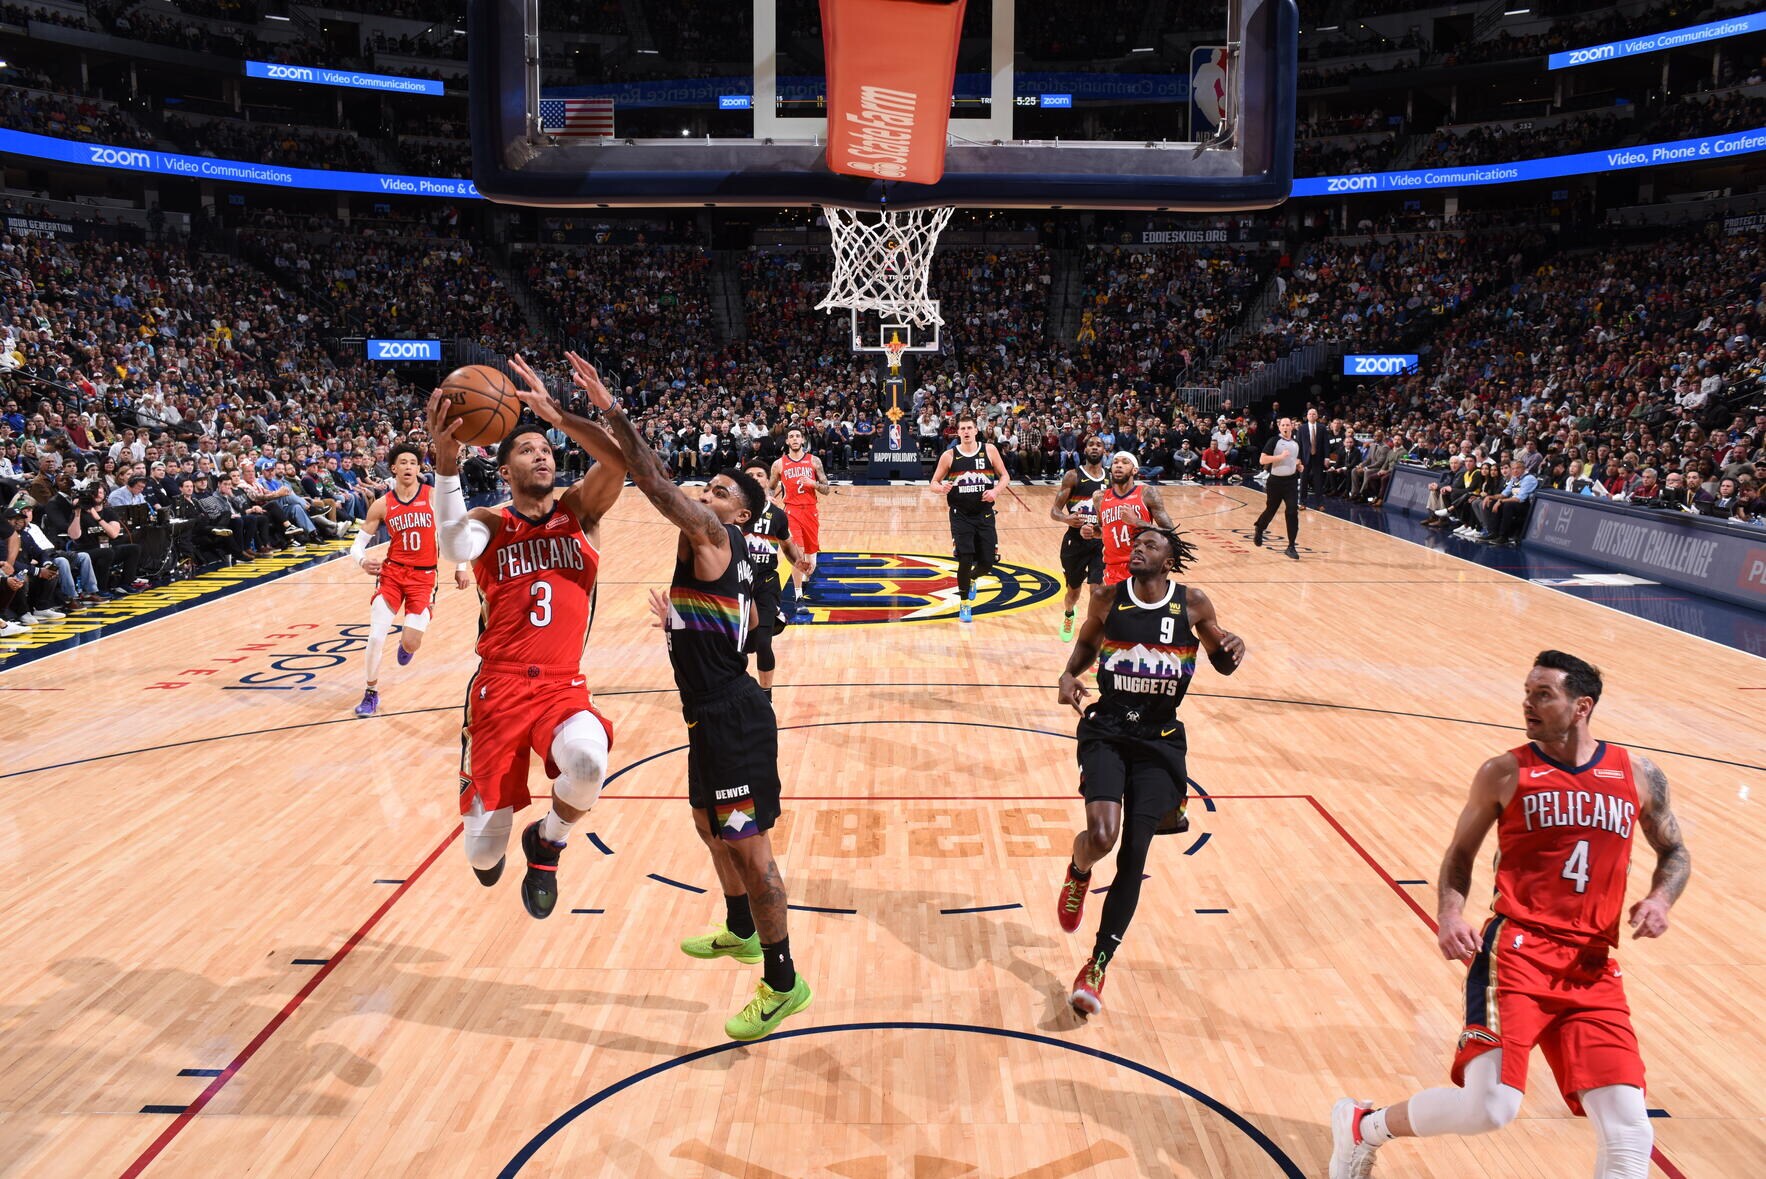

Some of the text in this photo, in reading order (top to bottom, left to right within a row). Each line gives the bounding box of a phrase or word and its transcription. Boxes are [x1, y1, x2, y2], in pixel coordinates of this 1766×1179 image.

[1569, 21, 1749, 64] zoom Video Communications
[267, 65, 426, 91] zoom Video Communications
[721, 98, 748, 106] zoom
[1016, 96, 1037, 106] 5:25
[1043, 97, 1069, 105] zoom
[1608, 153, 1649, 166] Video,
[1652, 146, 1696, 161] Phone
[1699, 142, 1711, 155] &
[90, 147, 292, 183] zoom Video Communications
[380, 178, 417, 192] Video,
[420, 181, 455, 193] Phone
[457, 184, 466, 194] &
[1328, 168, 1518, 191] zoom Video Communications
[1142, 230, 1227, 243] EDDIESKIDS.ORG
[378, 342, 430, 357] zoom
[1355, 358, 1406, 372] zoom
[874, 452, 917, 462] HAPPY HOLIDAYS
[975, 458, 985, 470] 15
[784, 466, 813, 480] PELICANS
[958, 484, 985, 493] NUGGETS
[389, 512, 432, 532] PELICANS
[1102, 504, 1141, 526] PELICS
[754, 518, 770, 534] 27
[402, 531, 421, 551] 10
[1112, 525, 1130, 548] 14
[497, 536, 584, 581] PELICANS
[752, 553, 770, 564] GETS
[1592, 519, 1719, 578] HOTSHOT CHALLENGE
[529, 580, 552, 627] 3
[1160, 617, 1175, 644] 9
[143, 624, 319, 691] CENTER
[1113, 674, 1178, 696] NUGGETS
[715, 785, 750, 800] DENVER
[1522, 791, 1635, 839] PELICANS
[1562, 840, 1590, 893] 4
